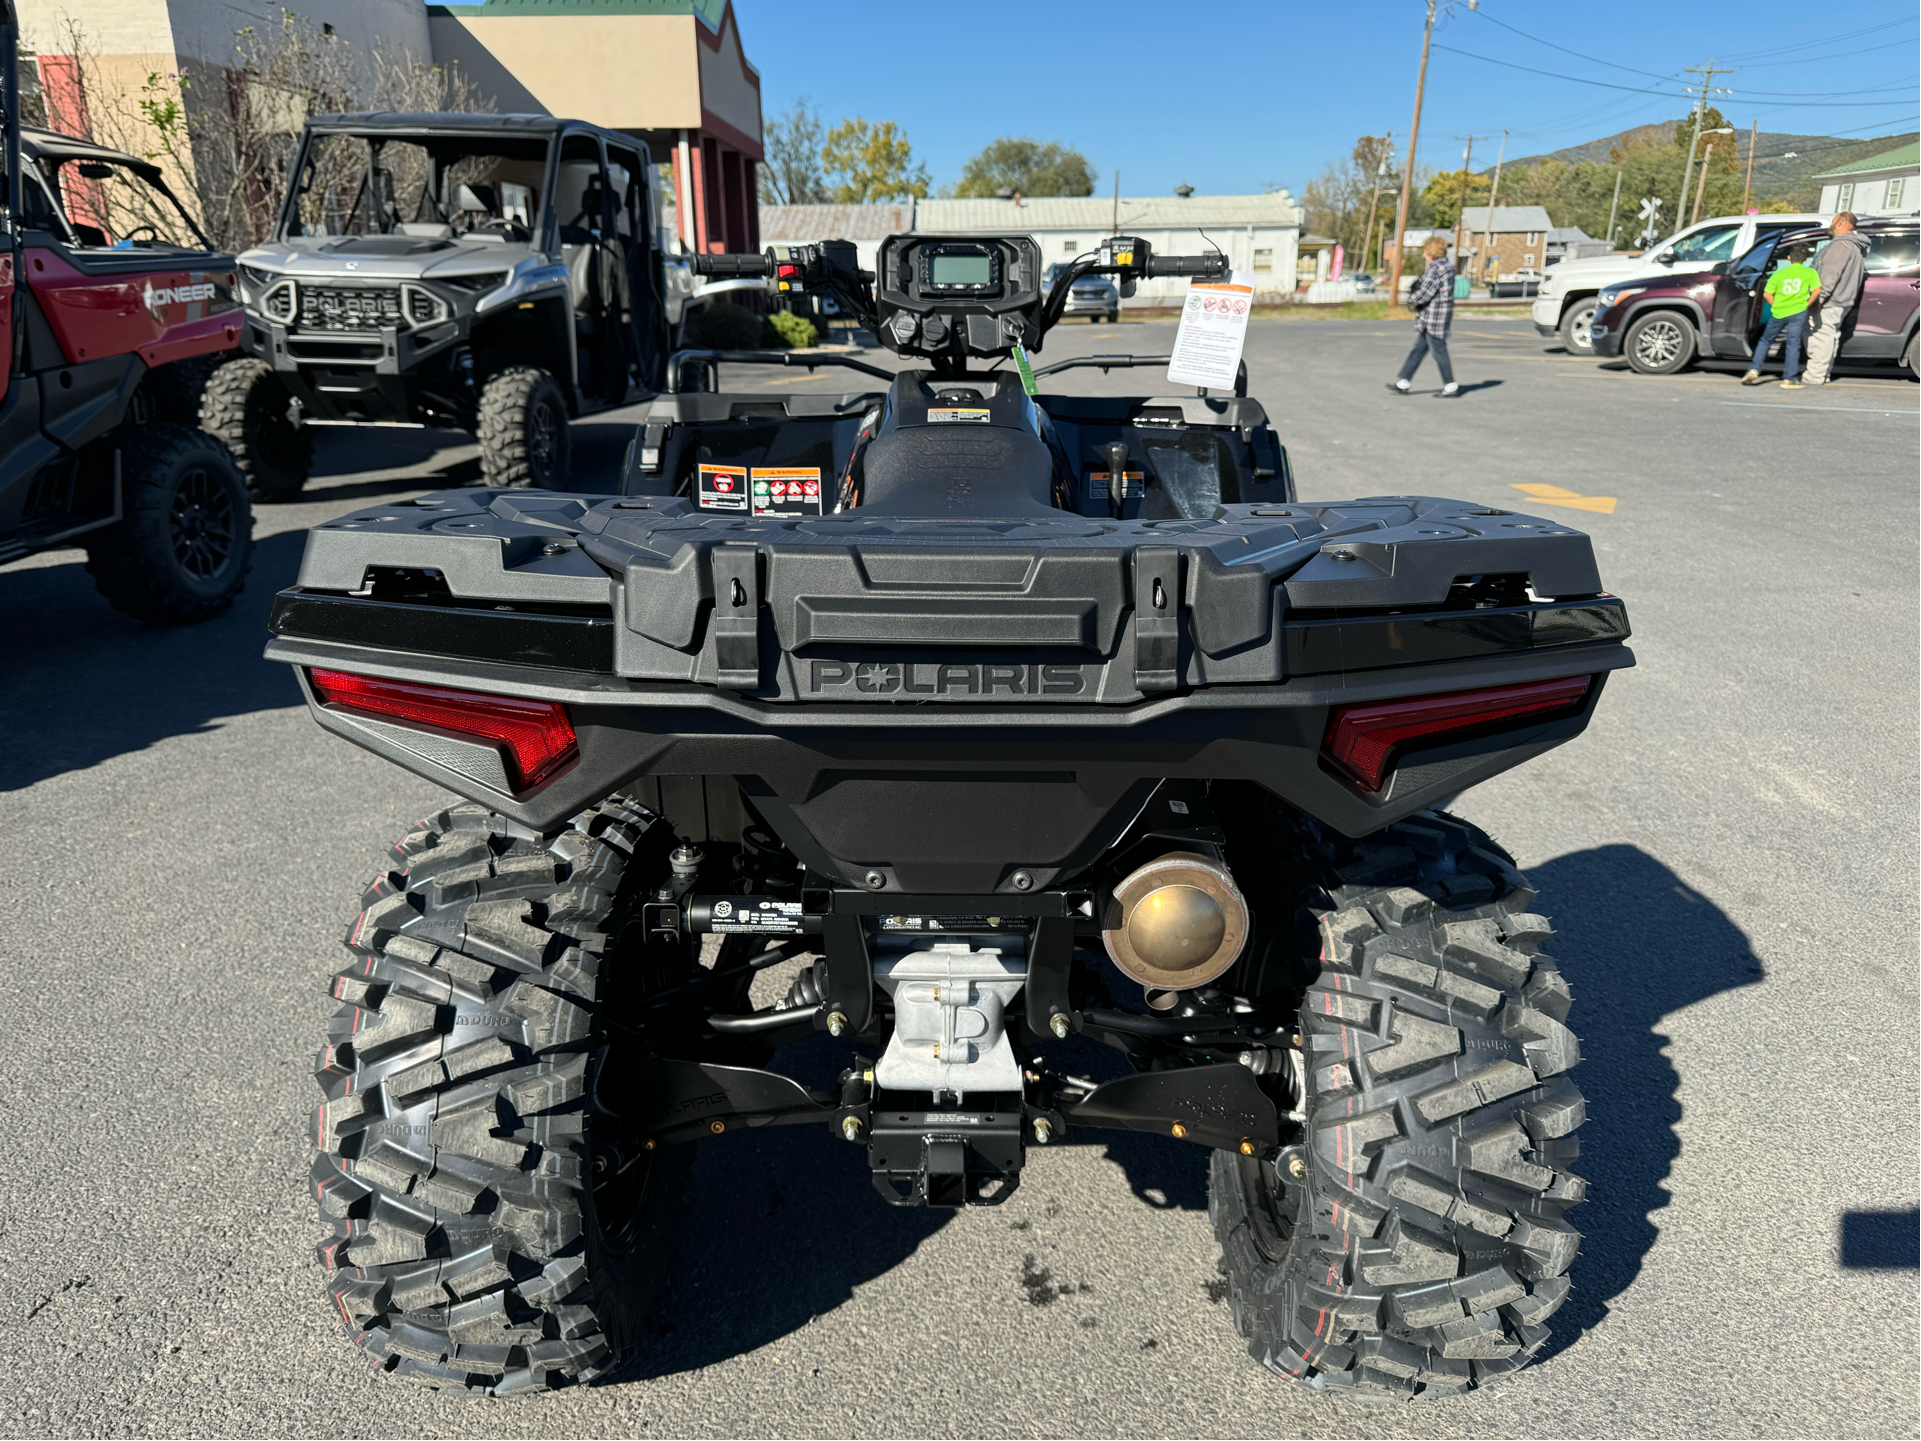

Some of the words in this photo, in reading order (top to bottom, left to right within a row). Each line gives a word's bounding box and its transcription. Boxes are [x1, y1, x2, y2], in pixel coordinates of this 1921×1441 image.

[1782, 277, 1802, 295] 69
[302, 295, 399, 313] POLARIS
[811, 660, 1087, 695] POLARIS
